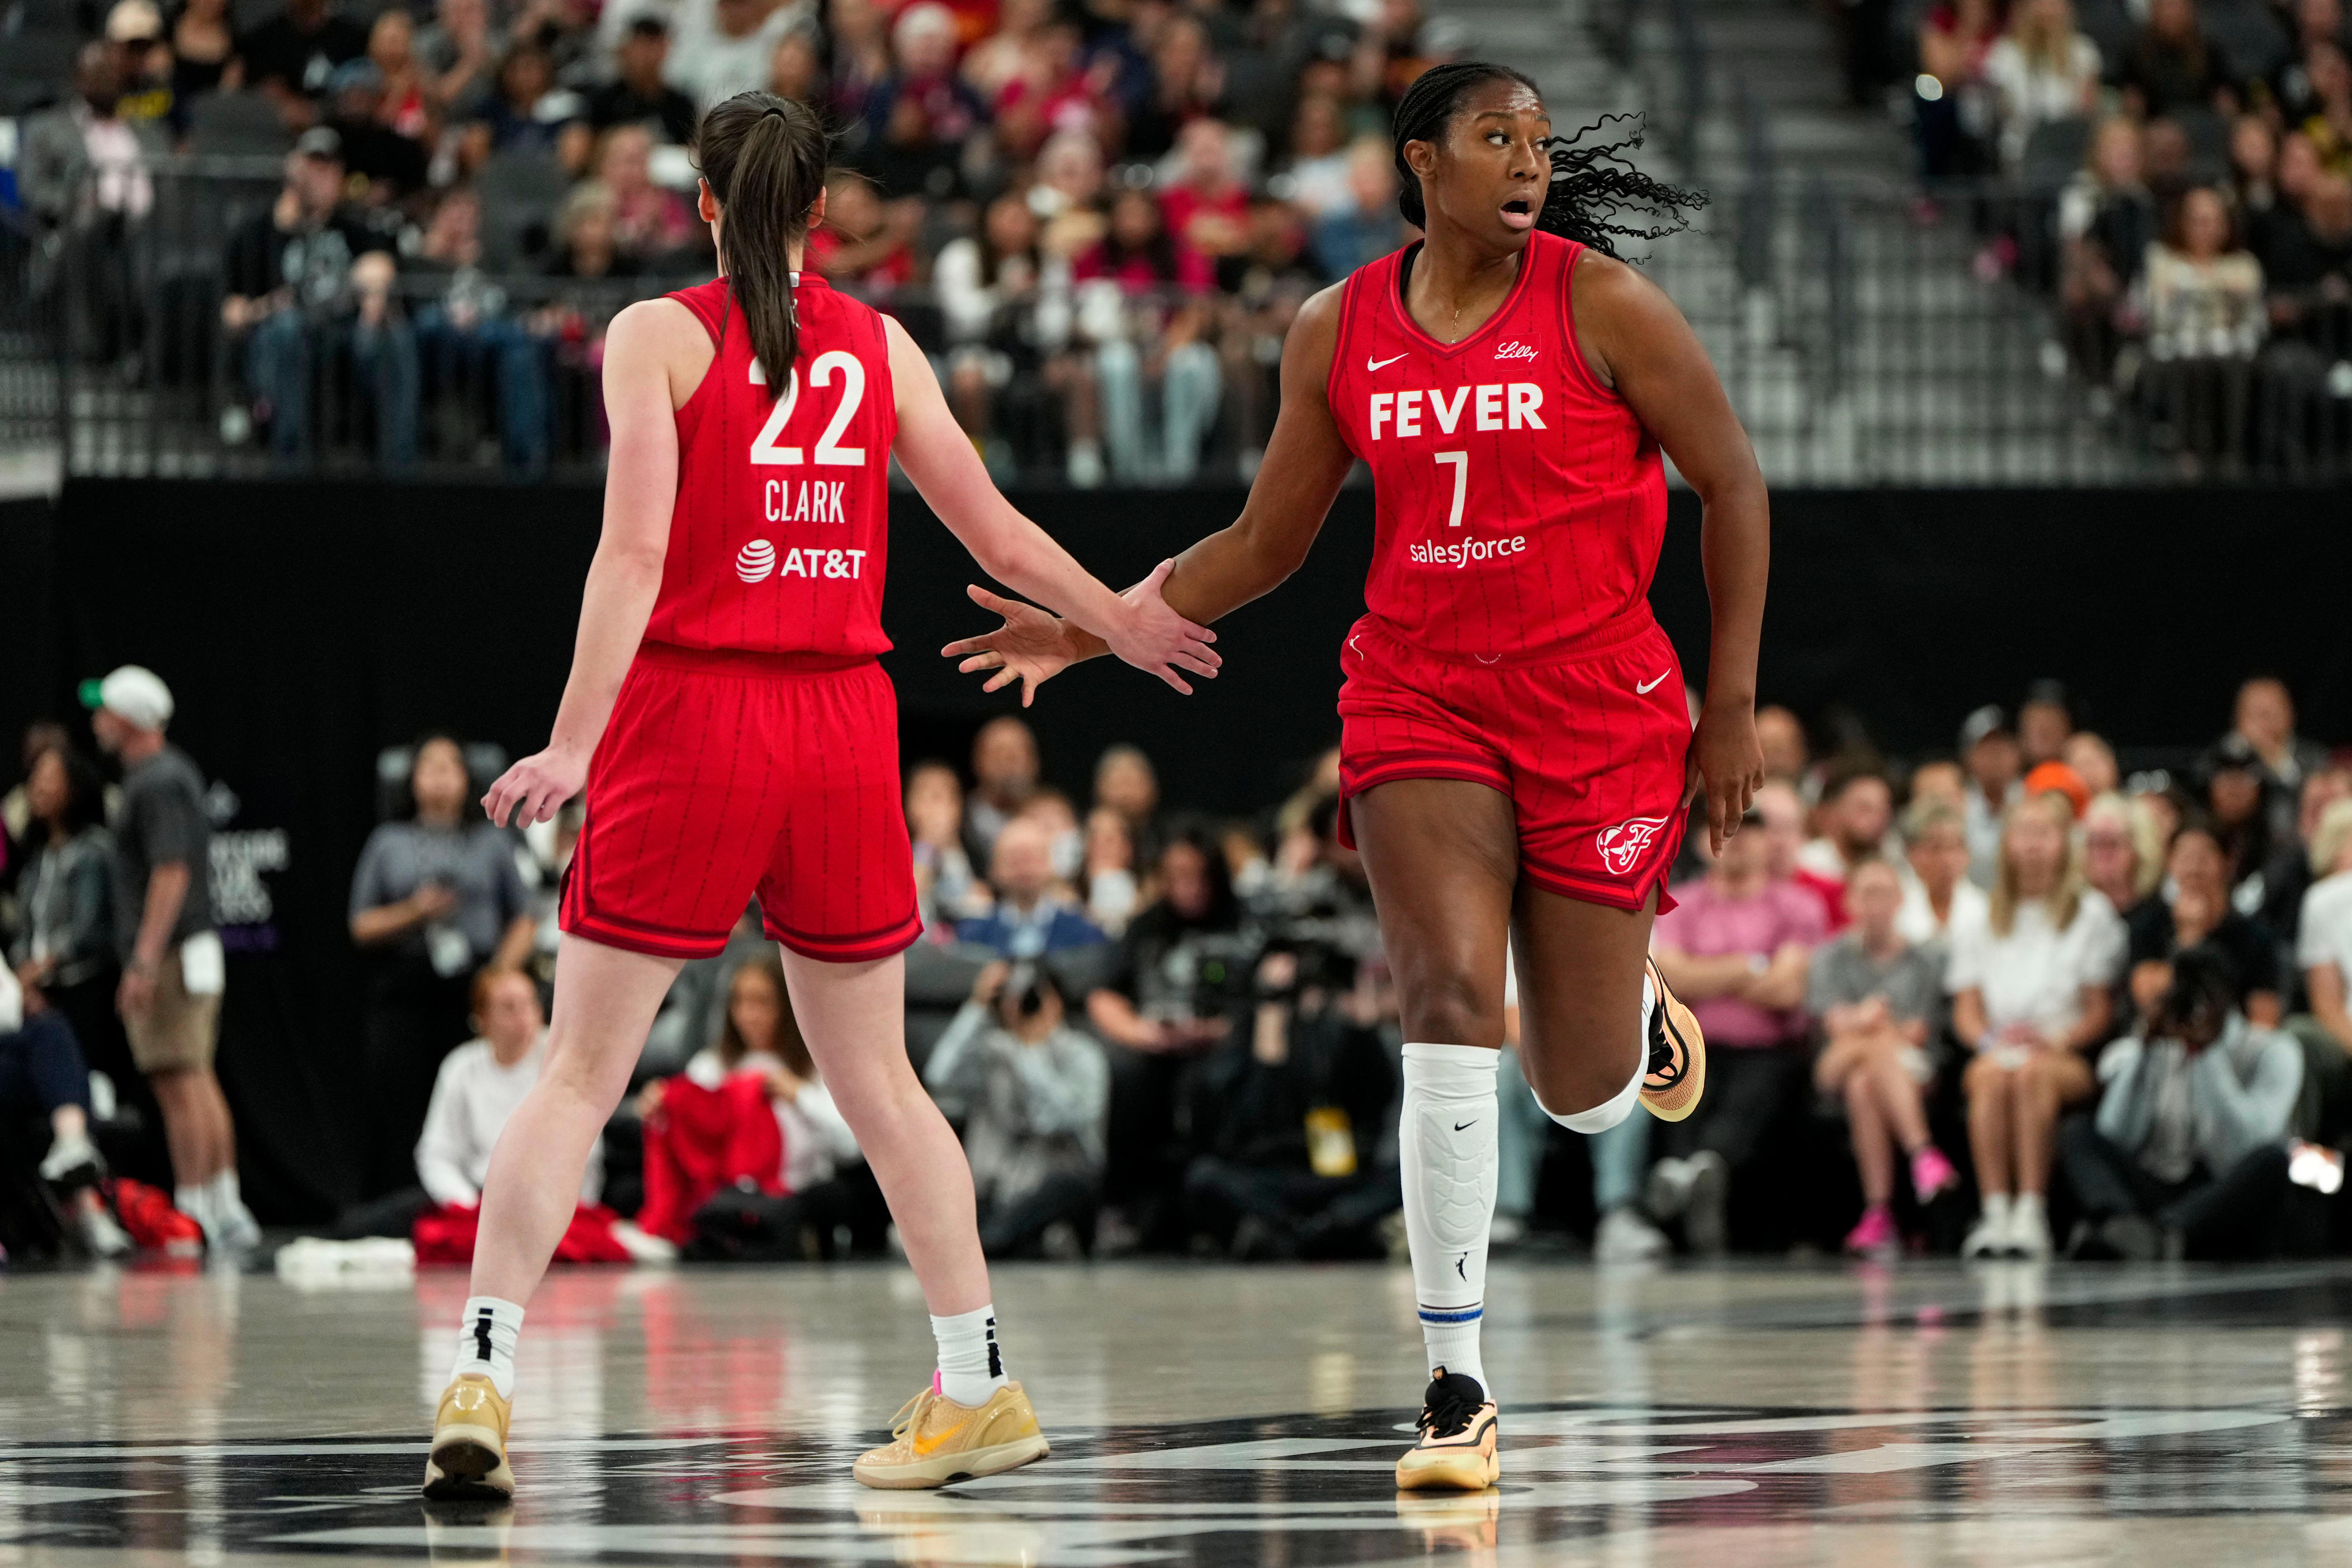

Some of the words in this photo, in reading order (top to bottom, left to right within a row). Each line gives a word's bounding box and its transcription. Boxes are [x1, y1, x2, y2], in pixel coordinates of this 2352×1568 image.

[1494, 340, 1539, 363] Lilly
[748, 350, 866, 466] 22
[1370, 382, 1548, 440] FEVER
[765, 479, 845, 524] CLARK
[1433, 451, 1469, 527] 7
[780, 547, 867, 580] AT&T
[1409, 536, 1526, 569] salesforce
